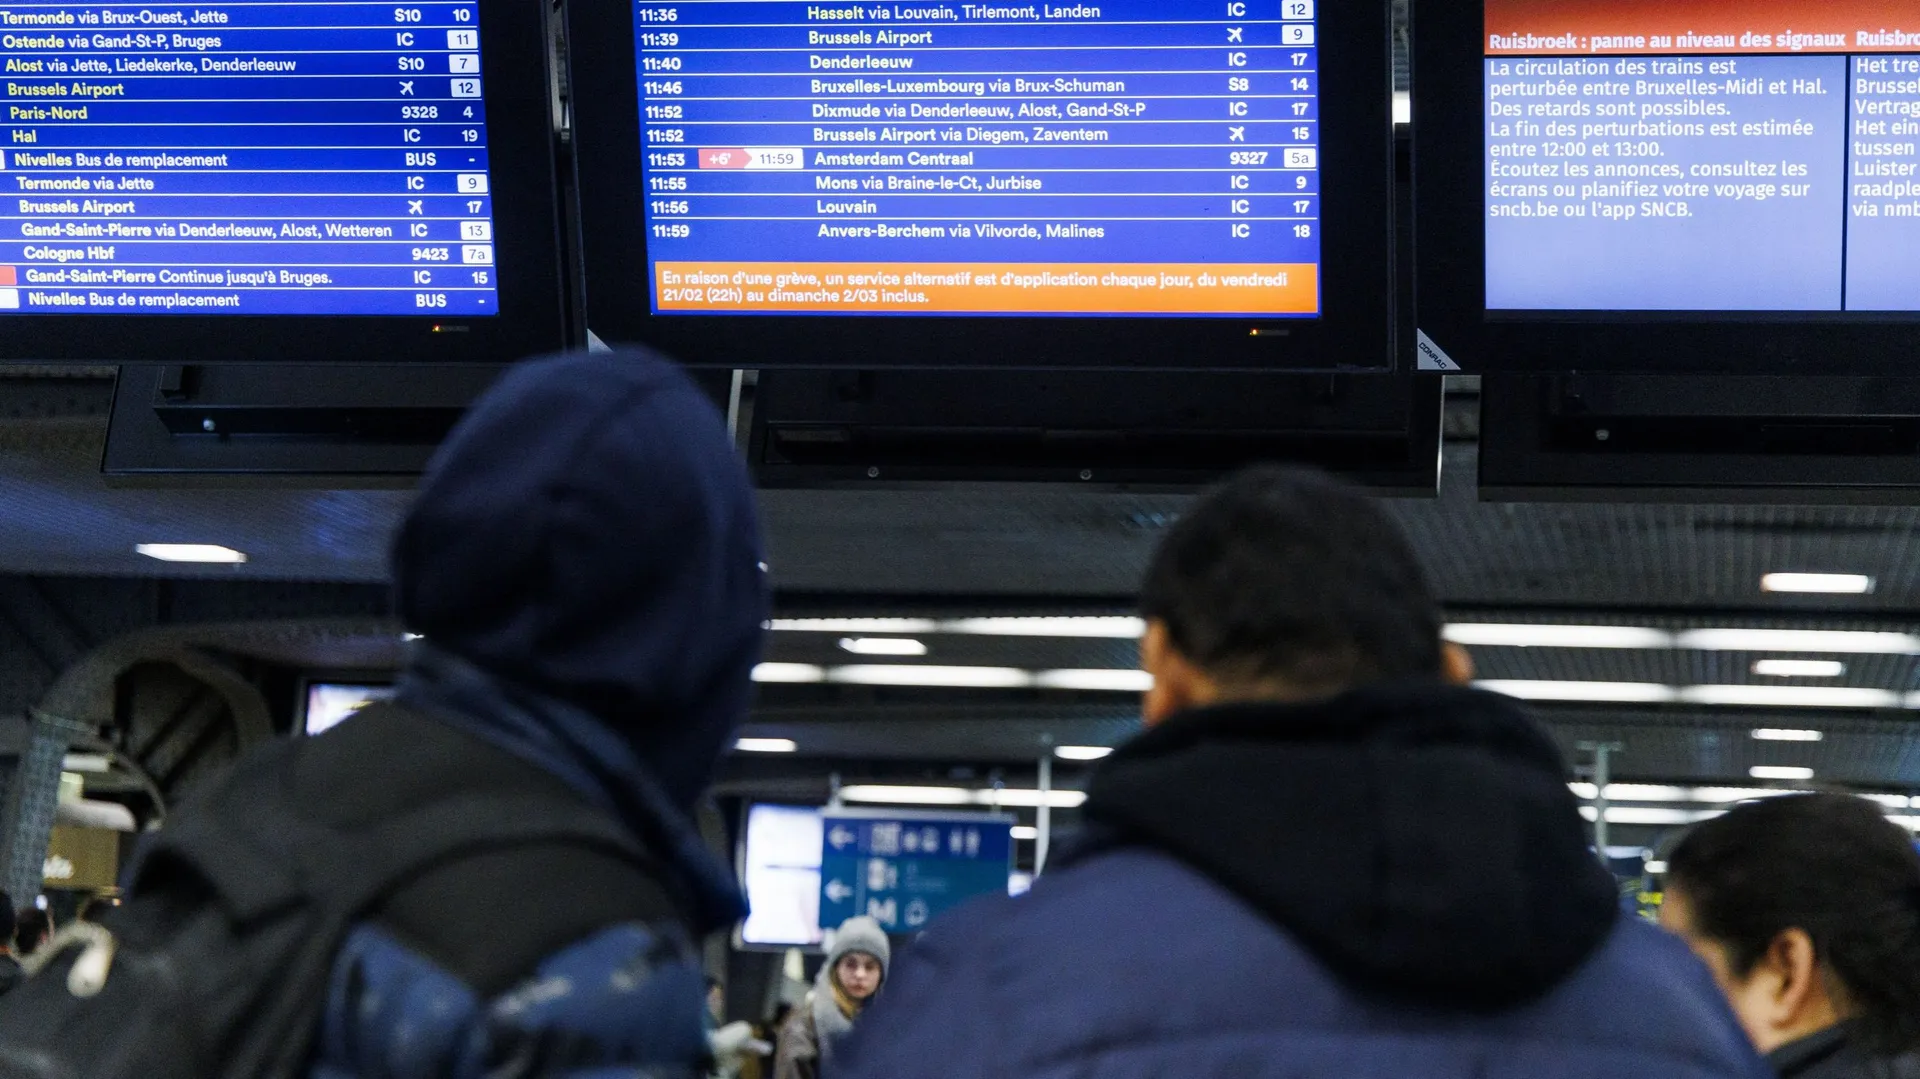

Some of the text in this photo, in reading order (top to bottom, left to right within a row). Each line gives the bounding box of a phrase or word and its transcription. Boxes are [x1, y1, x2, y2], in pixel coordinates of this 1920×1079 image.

[1, 8, 421, 26] Termonde via Brux-Ouest, Jette S10
[640, 3, 1306, 22] 11:36 Hasselt via Louvain, Tirlemont, Landen 12
[2, 34, 222, 50] Ostende via Gand-St-P, Bruges
[641, 30, 932, 47] 11:39 Brussels Airport
[1490, 30, 1846, 52] Ruisbroek panne niveau des signaux
[6, 56, 424, 74] Alost via Jette, Liedekerke, Denderleeuw S10
[642, 53, 1308, 70] 11:40 Denderleeuw 17
[1515, 58, 1736, 76] circulation des trains est
[8, 82, 124, 98] Brussels Airport
[644, 76, 1309, 96] 11:46 Bruxelles-Luxembourg via Brux-Schuman S8 14
[1490, 78, 1827, 98] perturbée entre Bruxelles-Midi Hal.
[10, 106, 438, 120] Paris-Nord 9328
[645, 102, 1308, 120] 11:52 Dixmude via Denderleeuw, Alost, Gand-St-P 17
[1490, 98, 1730, 118] Des retards sont possibles.
[12, 130, 36, 143] Hal
[647, 127, 1310, 144] 11:52 Brussels Airport via Diegem, Zaventem 15
[1515, 118, 1814, 138] fin des perturbations est estimée
[1490, 142, 1664, 157] entre 12:00 13:00.
[1854, 141, 1914, 156] tussen
[14, 152, 436, 168] Nivelles Bus de remplacement BUS
[648, 153, 685, 166] 11:53
[760, 153, 794, 164] 11:59
[814, 152, 903, 166] Amsterdam
[907, 151, 973, 166] Centraal
[1230, 152, 1268, 165] 9327
[1292, 152, 1309, 164] 5a
[1491, 160, 1808, 179] Écoutez les annonces, consultez les
[1854, 160, 1917, 176] Luister
[16, 176, 154, 190] Termonde via Jette
[650, 176, 1042, 192] 11:55 Mons via Braine-le-Ct, Jurbise
[1490, 180, 1810, 200] écrans planifiez votre voyage sur
[651, 200, 1310, 214] 11:56 Louvain 17
[1490, 201, 1692, 220] sncb.be l'app SNCB.
[21, 222, 392, 239] Gand-Saint-Pierre via Denderleeuw, Alost, Wetteren
[652, 224, 1310, 240] 11:59 Anvers-Berchem via Vilvorde, Malines 18
[23, 246, 449, 262] Cologne Hbf 9423
[26, 268, 332, 286] Gand-Saint-Pierre Continue jusqu'à Bruges.
[684, 270, 1288, 290] raison d'une grève, service alternatif est d'application chaque jour, vendredi
[663, 288, 929, 304] 21/02 (22h) dimanche 2/03 inclus.
